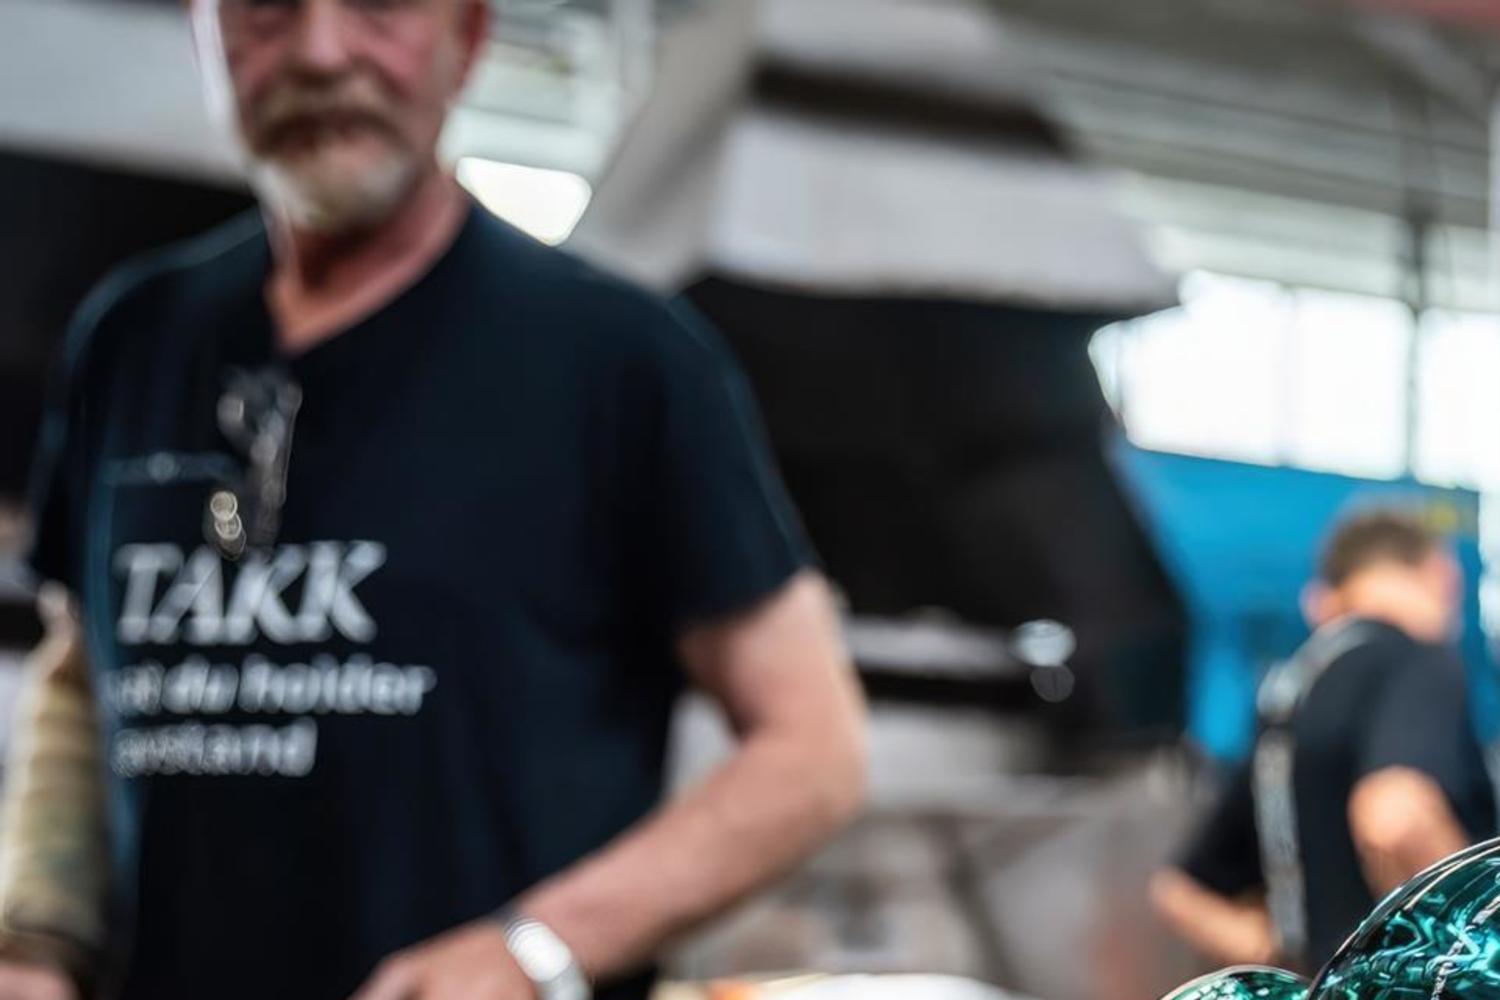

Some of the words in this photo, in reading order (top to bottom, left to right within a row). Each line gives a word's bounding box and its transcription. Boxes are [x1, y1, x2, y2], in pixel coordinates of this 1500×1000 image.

[113, 540, 387, 645] TAKK
[163, 655, 238, 713] du
[239, 653, 437, 715] holder
